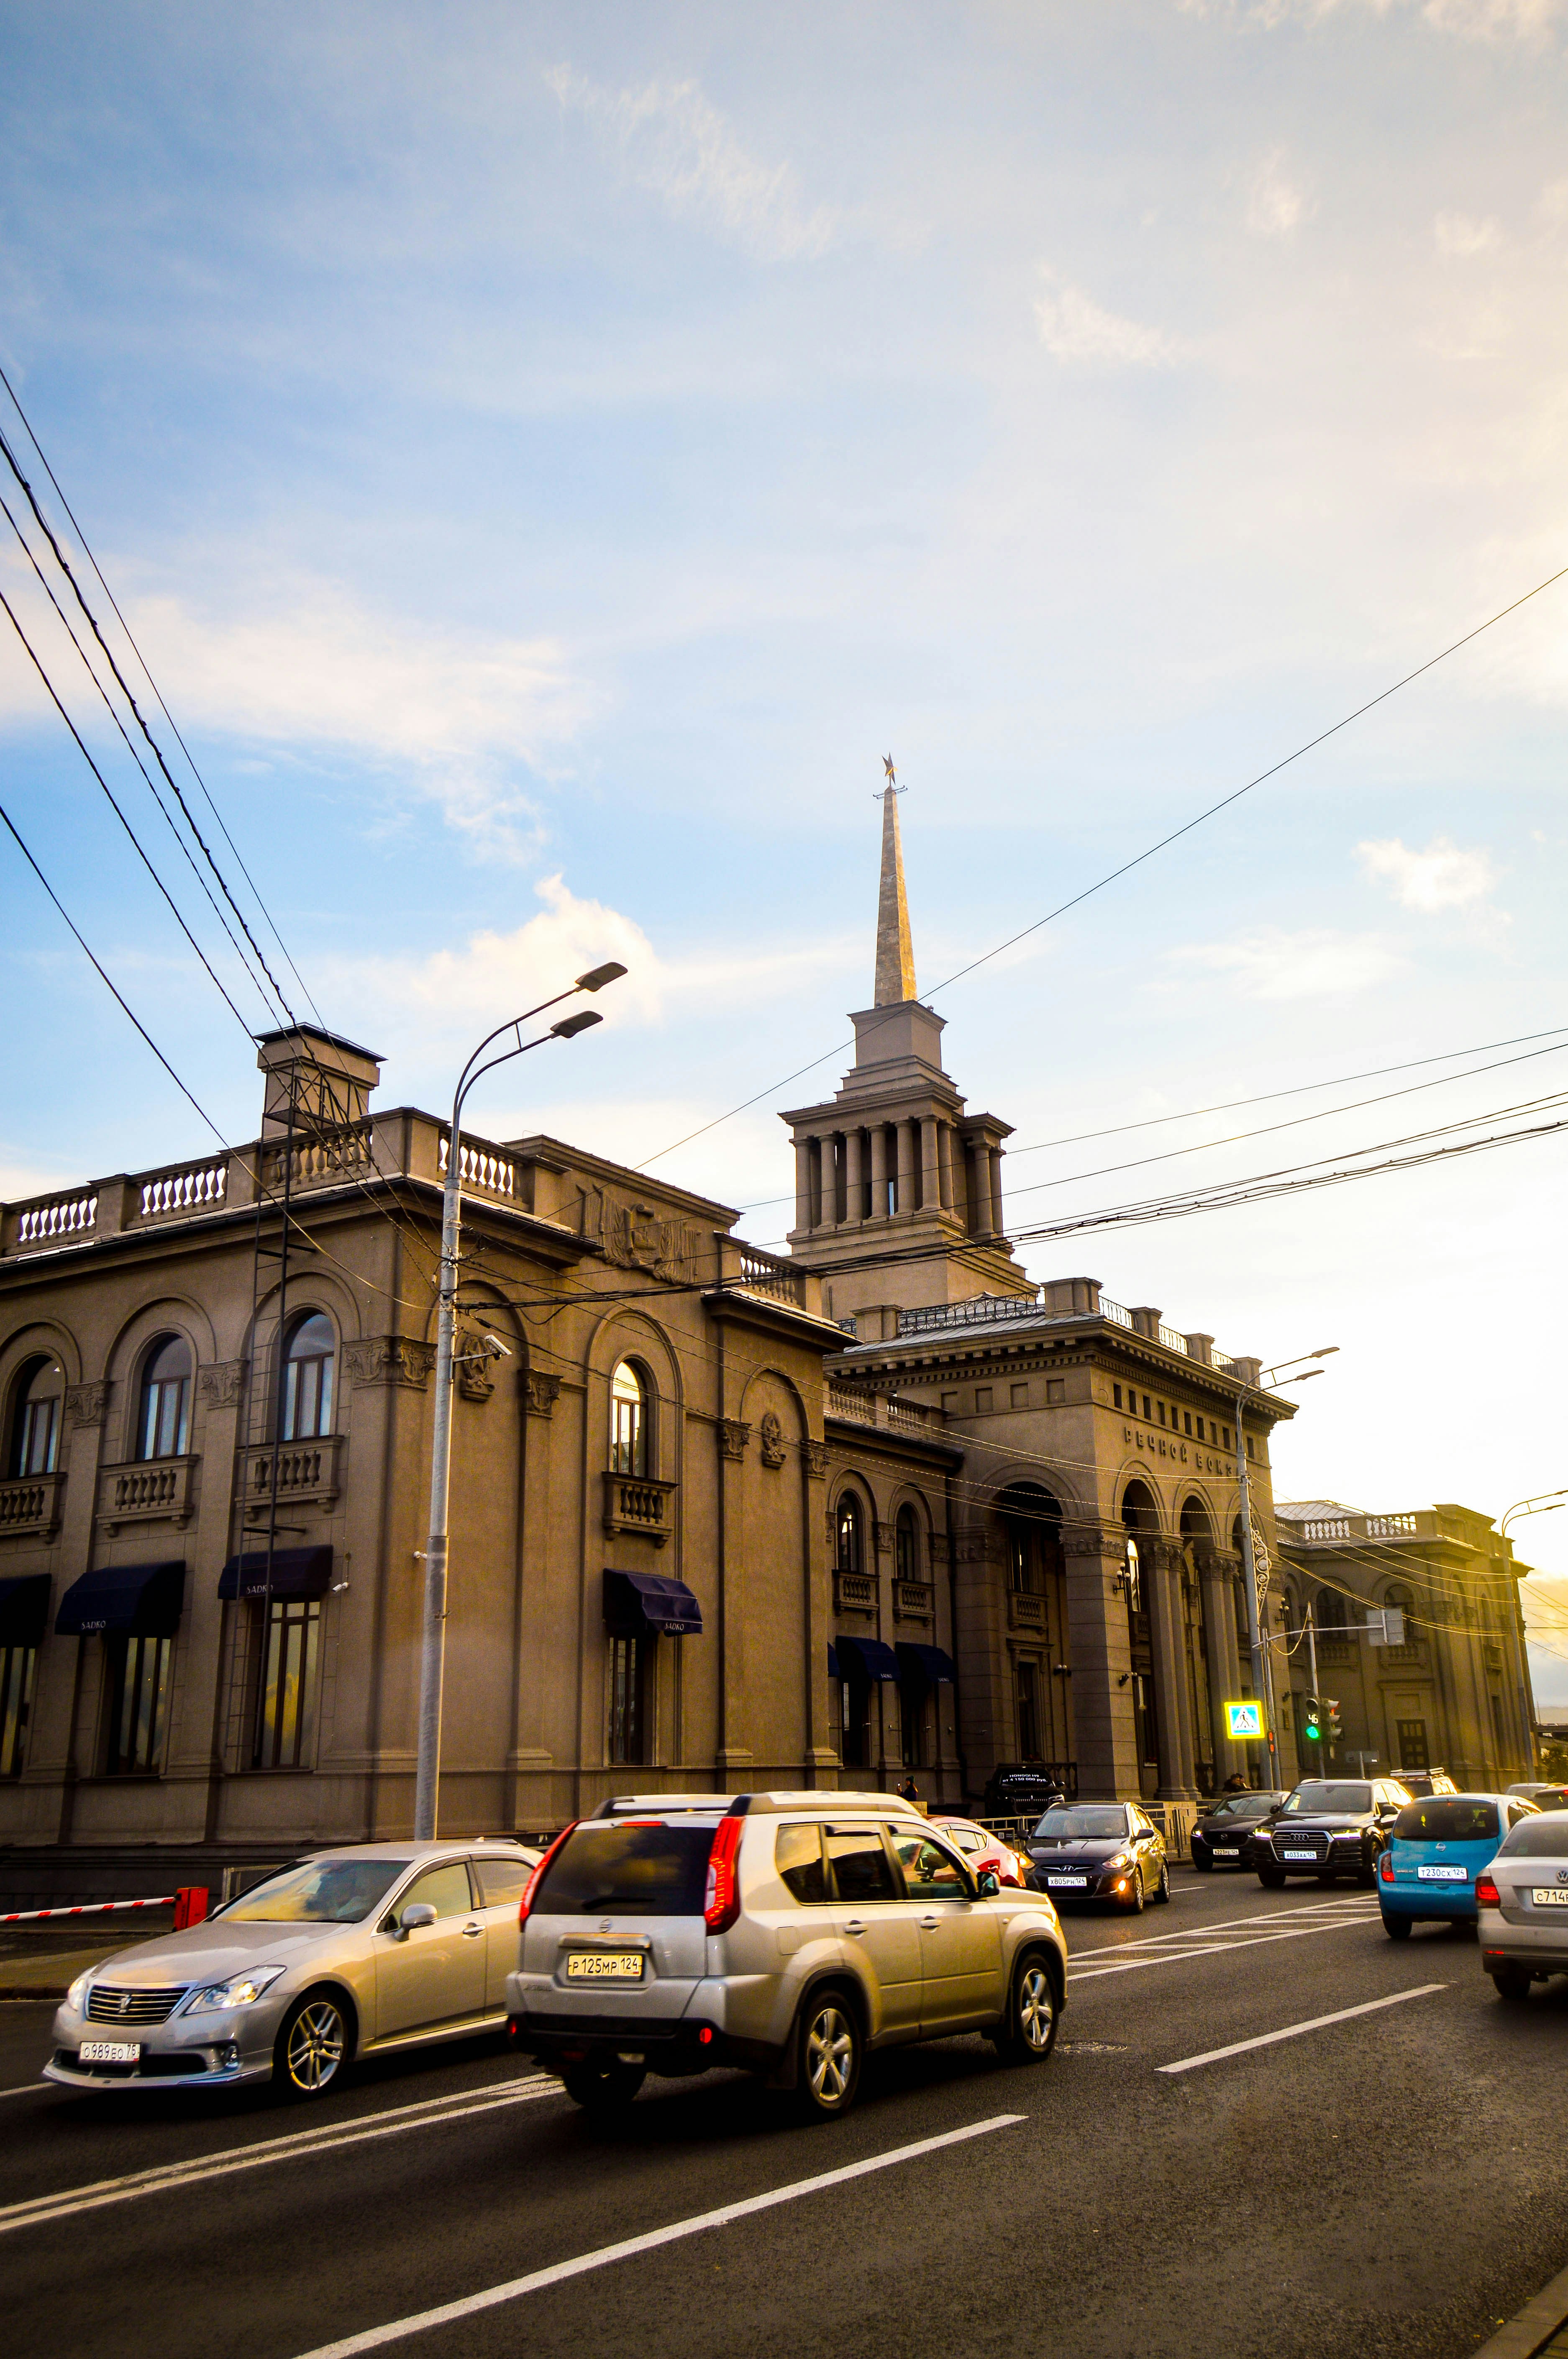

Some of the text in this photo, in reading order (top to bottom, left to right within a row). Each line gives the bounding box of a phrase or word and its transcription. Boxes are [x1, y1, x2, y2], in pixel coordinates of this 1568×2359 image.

[1125, 1427, 1238, 1477] РЕЧНОЙ ВОКЗ
[81, 1620, 106, 1630] SADKO
[665, 1622, 684, 1631] SADKO
[1308, 1714, 1319, 1724] 46
[621, 1958, 638, 1969] 124
[127, 2044, 136, 2056] 75
